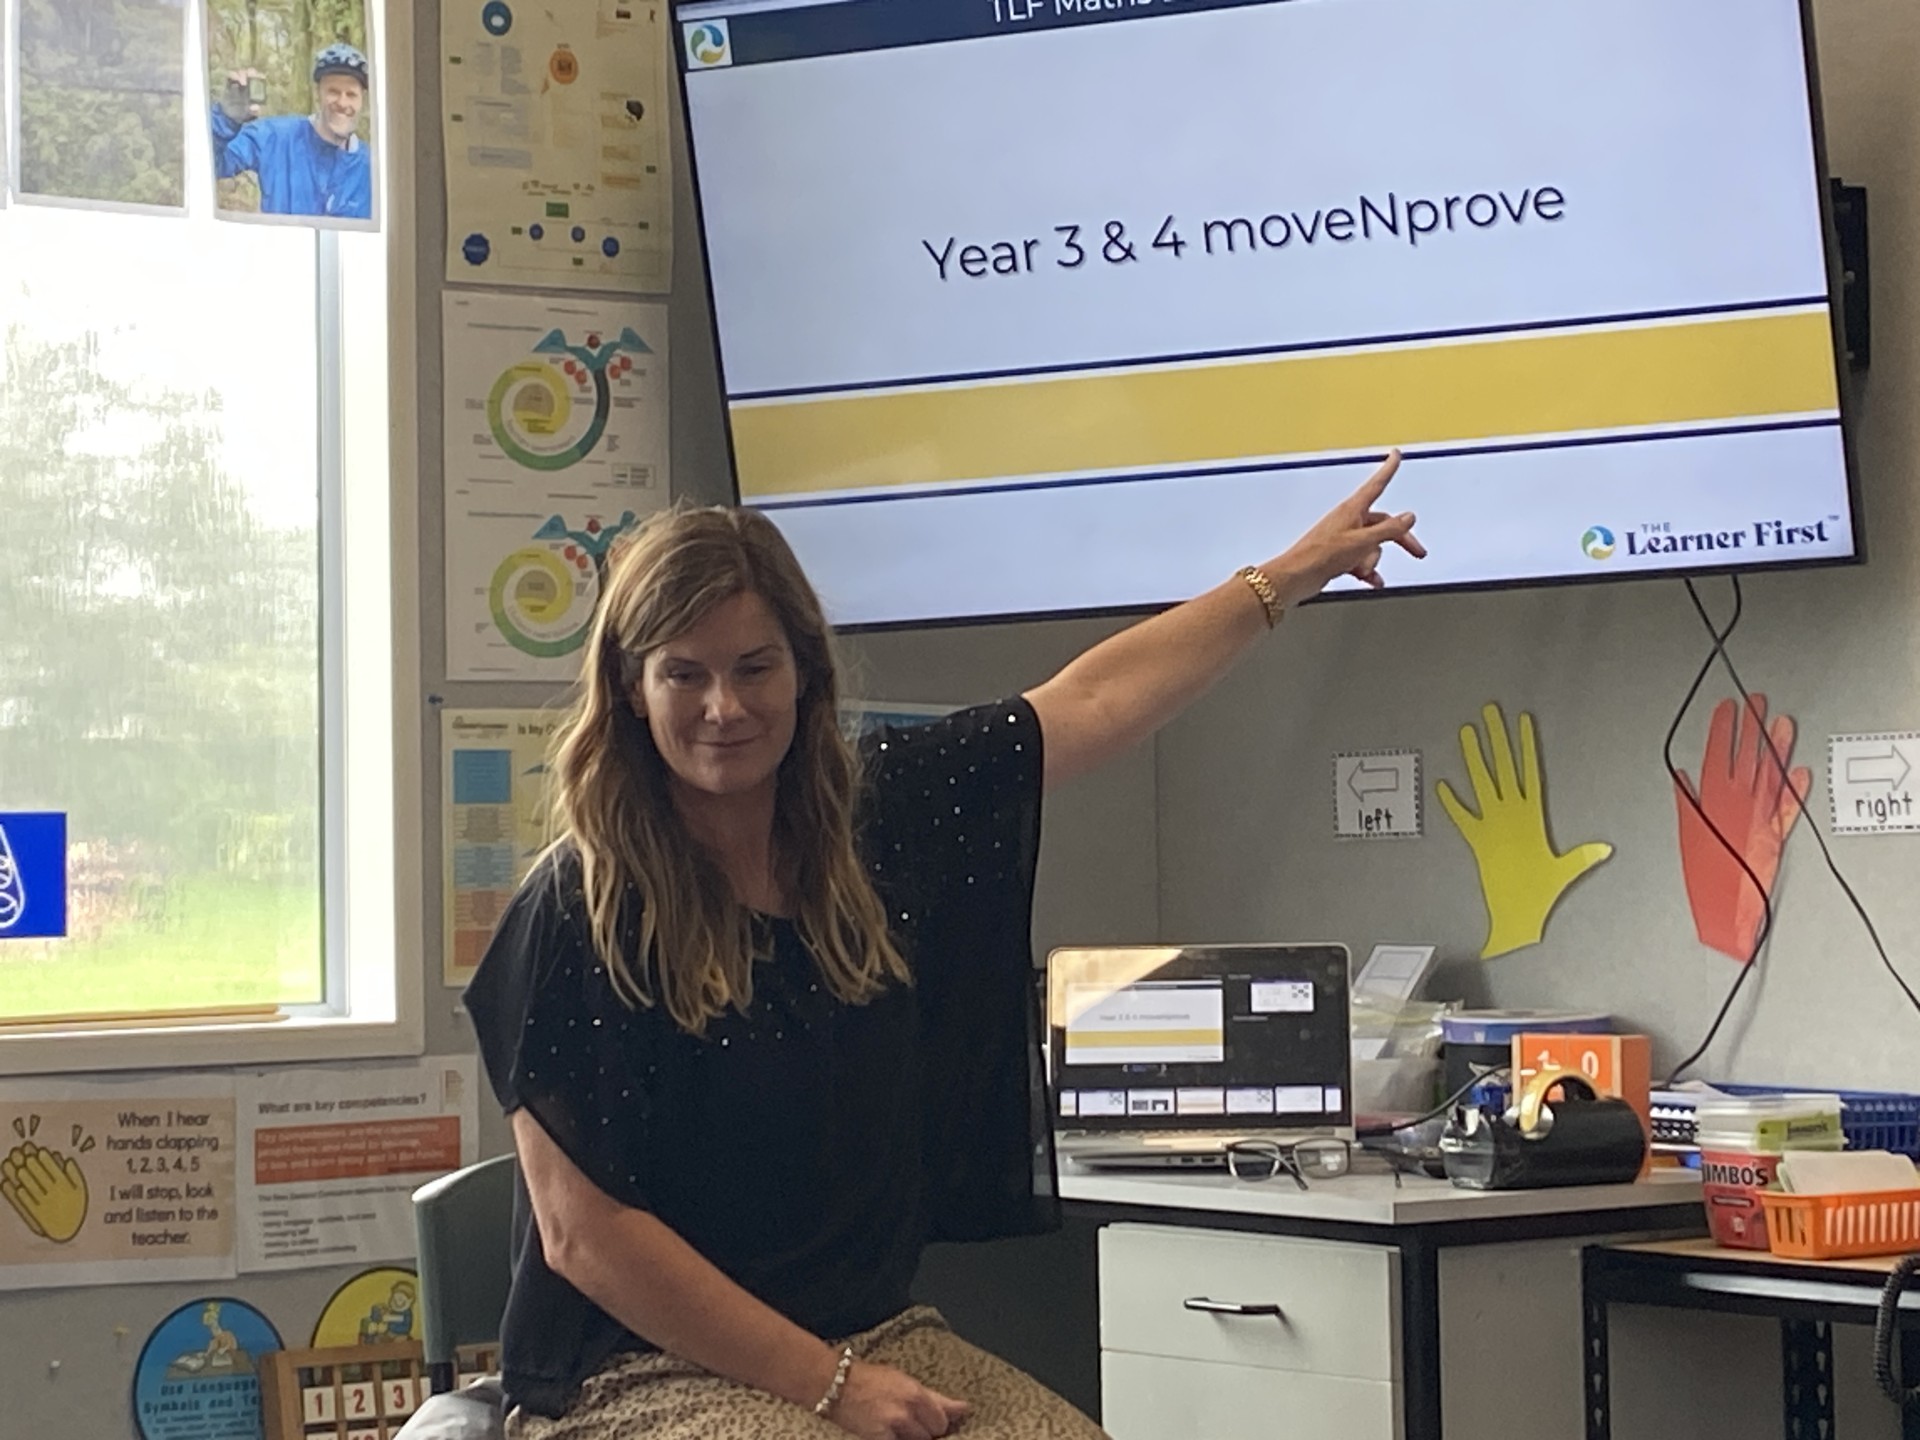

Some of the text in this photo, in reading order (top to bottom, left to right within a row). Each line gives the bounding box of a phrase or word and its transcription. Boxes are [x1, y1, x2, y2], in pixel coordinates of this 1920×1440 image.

[987, 0, 1151, 22] TLF Mat
[922, 186, 1566, 281] Year 3 & 4 moveNprove
[1625, 530, 1746, 556] Learner
[1753, 520, 1829, 547] First
[1641, 522, 1671, 534] THE
[1855, 791, 1913, 823] right
[1358, 807, 1394, 831] left
[118, 1111, 160, 1128] When
[177, 1111, 211, 1127] hear
[106, 1134, 220, 1152] hands clapping
[110, 1182, 214, 1201] I will stop, look
[104, 1205, 219, 1224] and listen to the
[313, 1384, 406, 1418] 1 2 3
